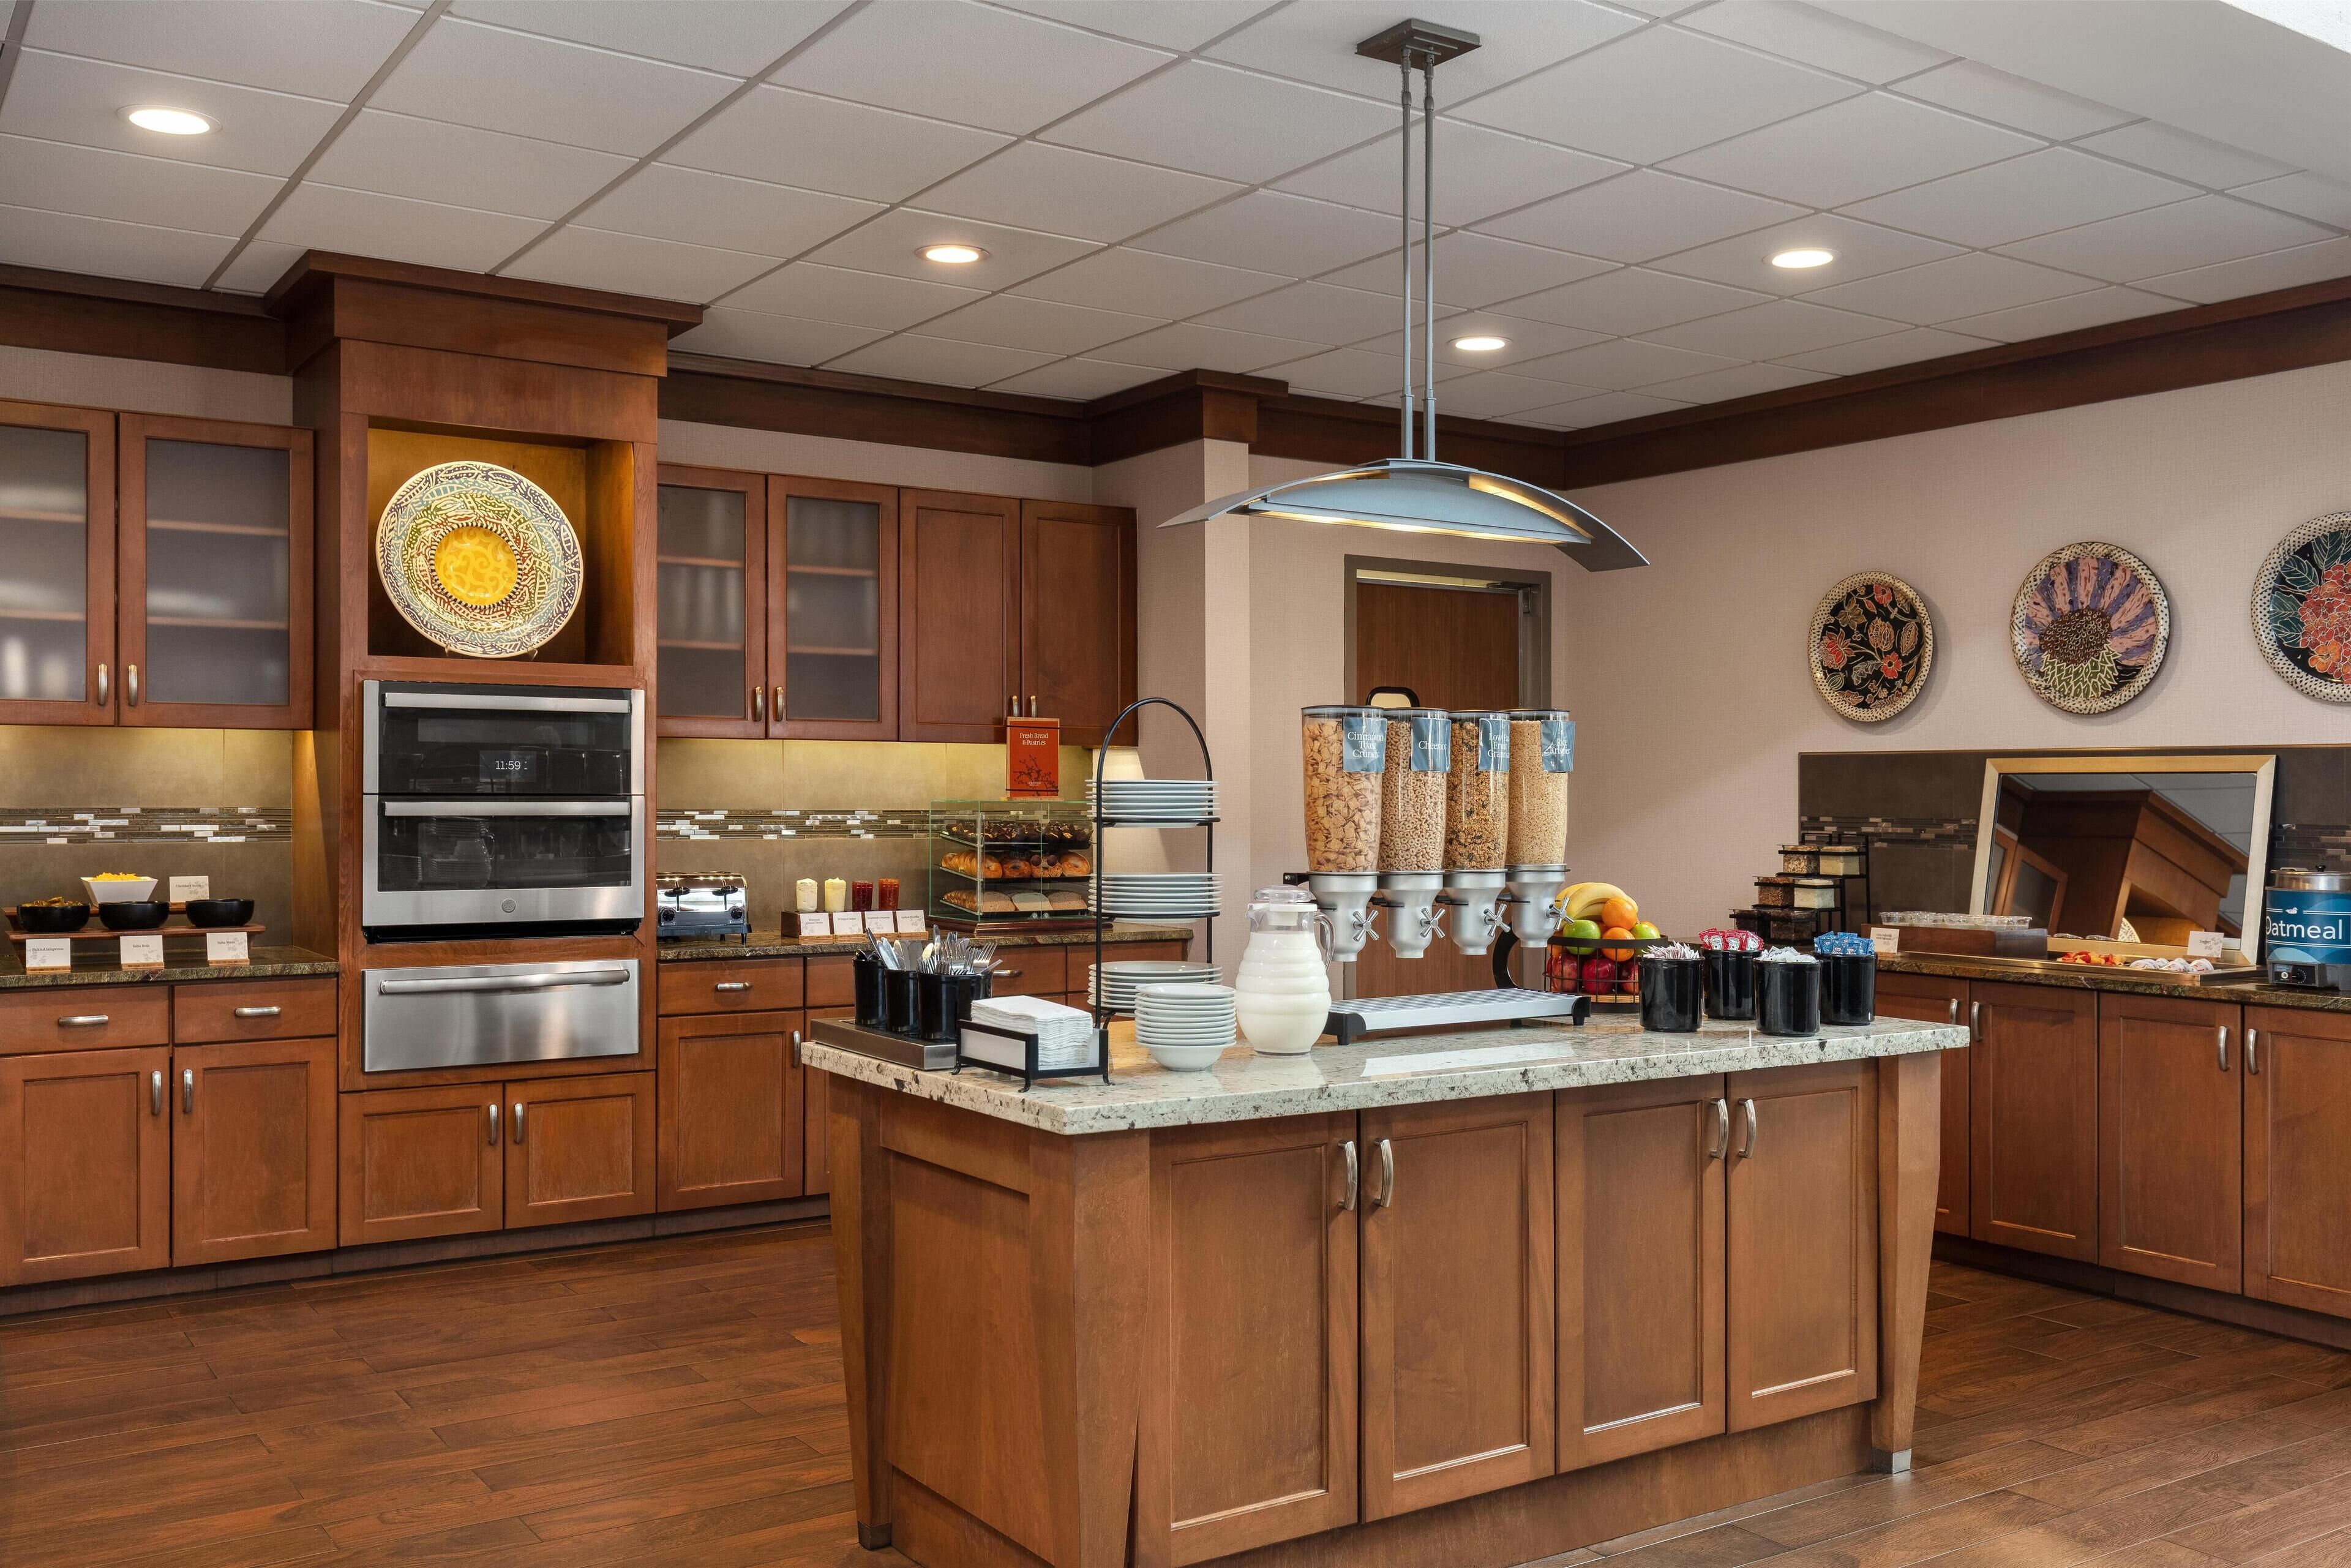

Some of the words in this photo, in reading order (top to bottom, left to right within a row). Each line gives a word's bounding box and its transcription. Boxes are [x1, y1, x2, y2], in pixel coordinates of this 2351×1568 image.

[1348, 732, 1384, 741] Cinnamon
[1359, 740, 1377, 749] Toast
[1418, 740, 1447, 750] Cheerios
[1493, 741, 1507, 750] Fruit
[1557, 738, 1568, 746] Rice
[1352, 749, 1380, 759] Crunch
[495, 760, 521, 770] 11:59
[2266, 916, 2342, 940] Oatmeal
